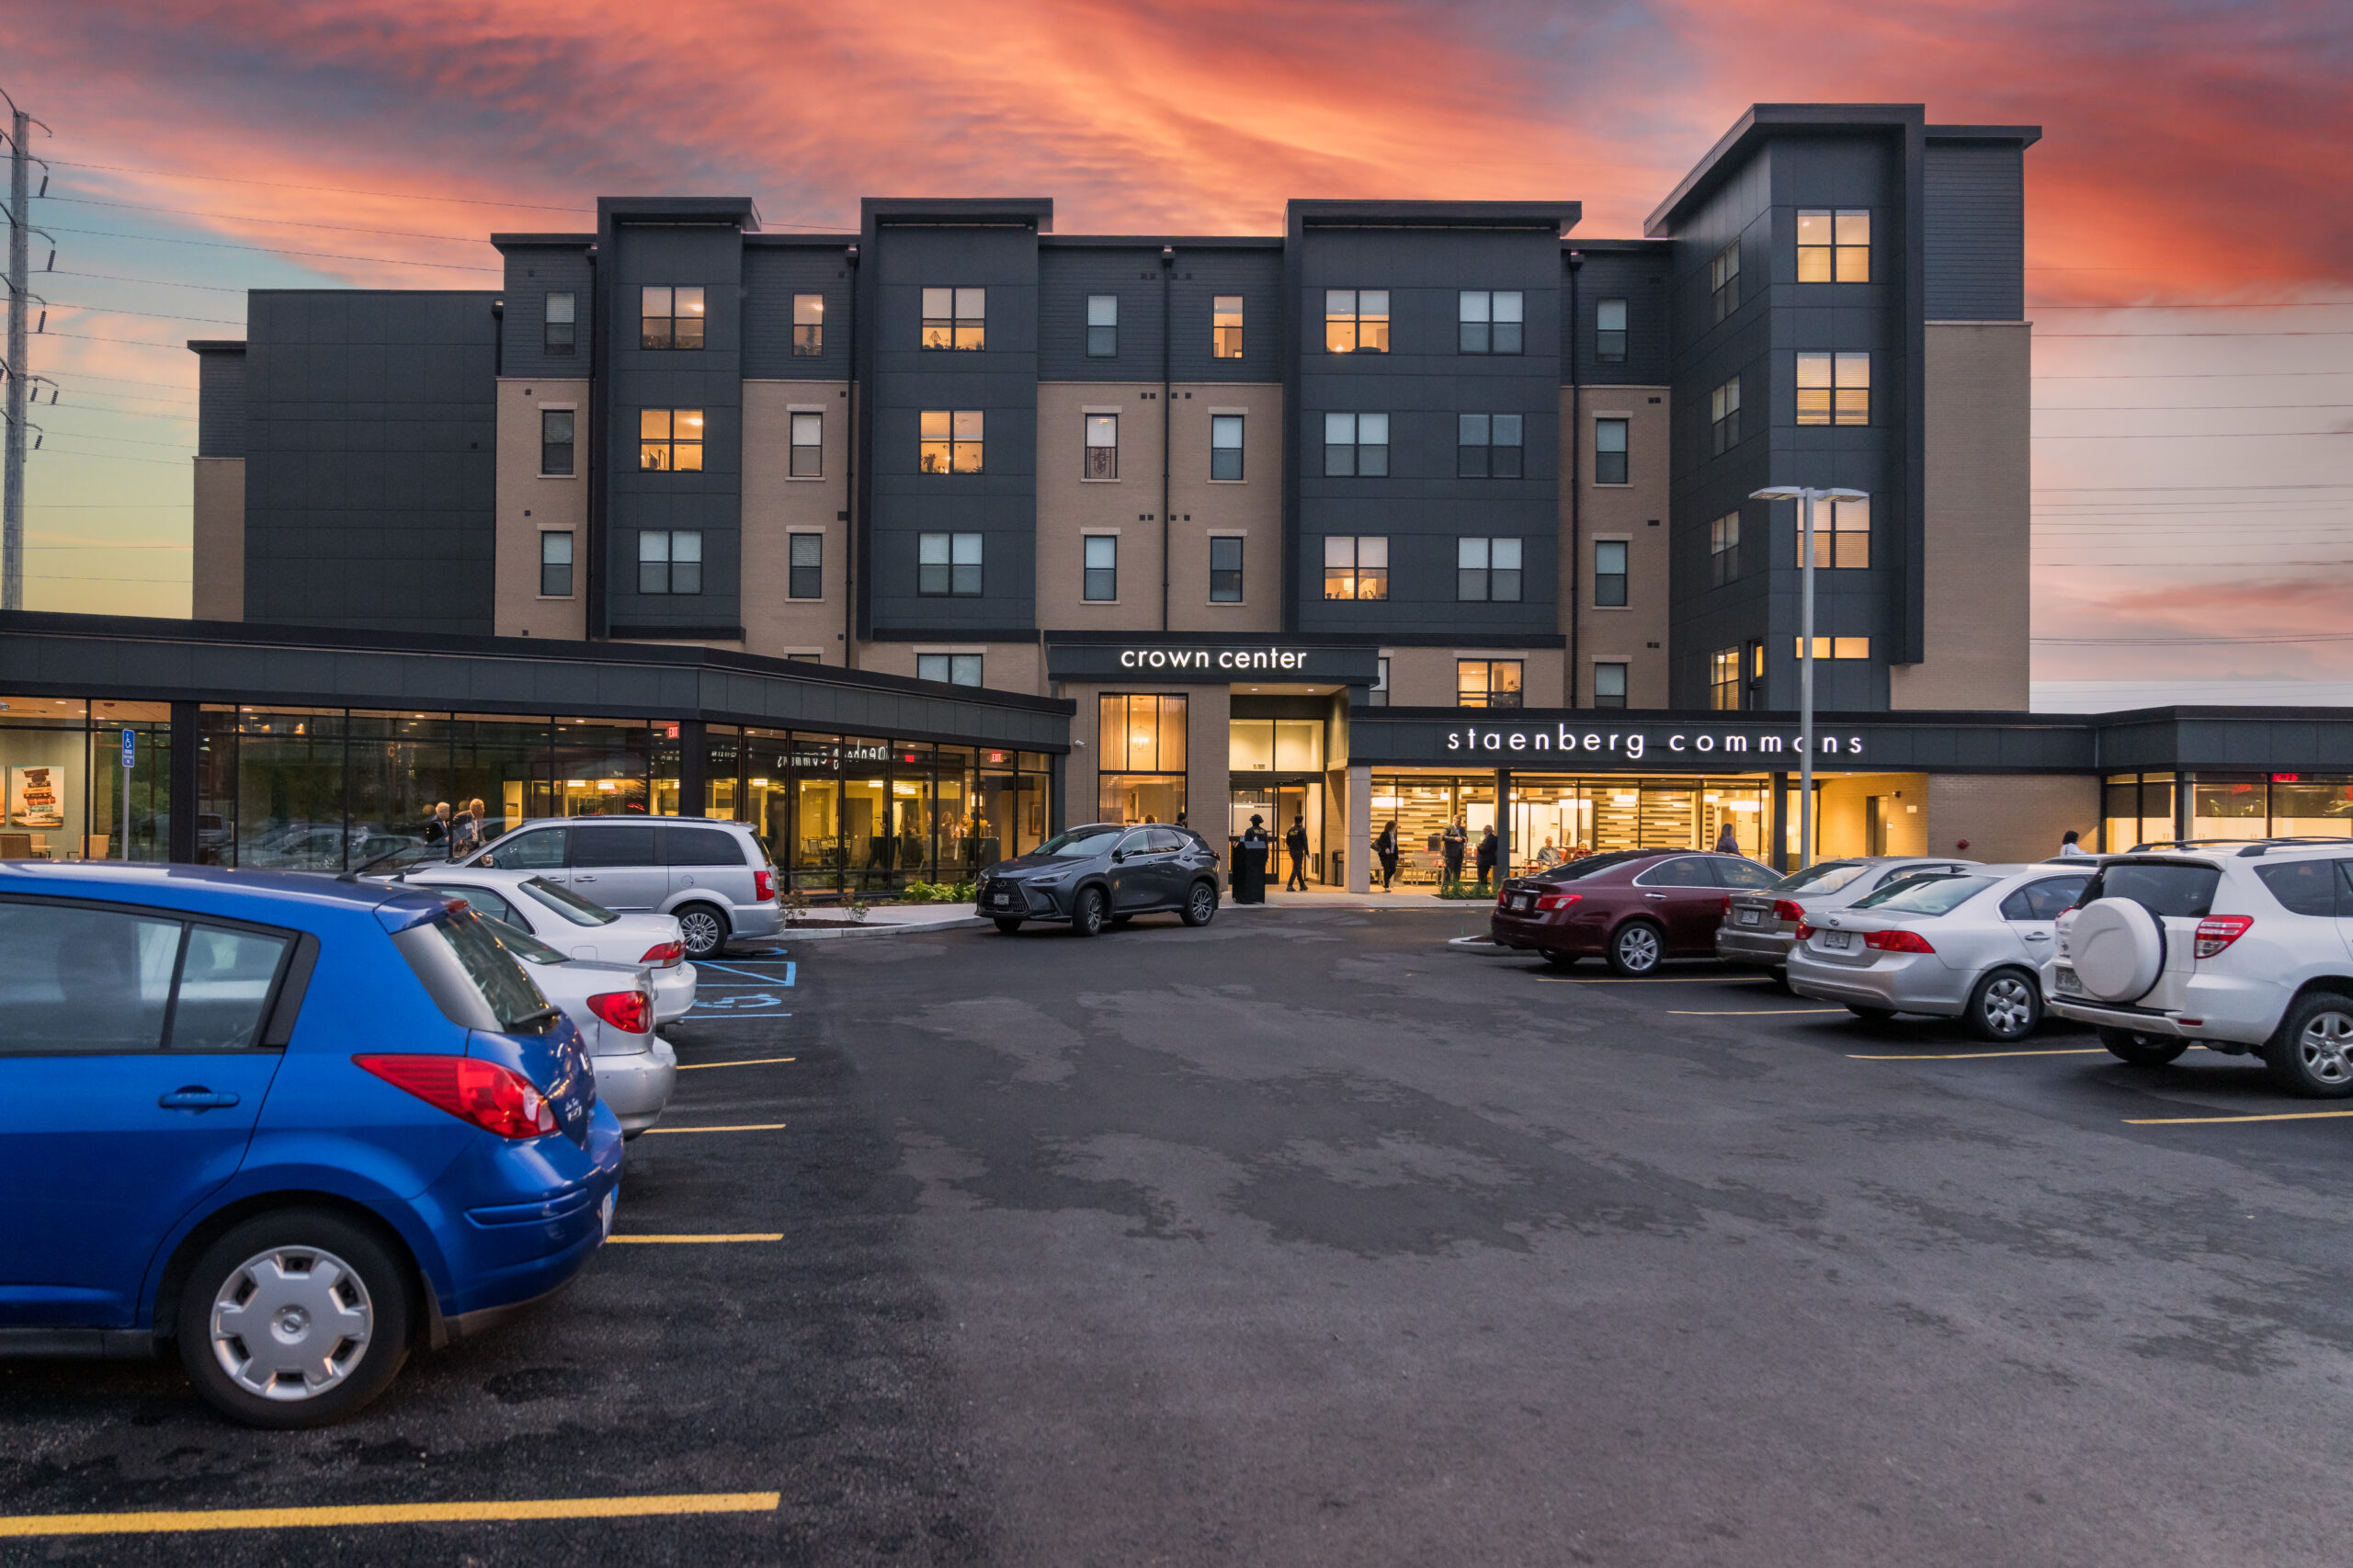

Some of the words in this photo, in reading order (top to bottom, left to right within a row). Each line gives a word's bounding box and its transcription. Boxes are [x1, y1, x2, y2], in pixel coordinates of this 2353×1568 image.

[1120, 650, 1210, 668] crown
[1218, 647, 1308, 669] center
[1447, 723, 1644, 759] staenberg
[1668, 734, 1862, 754] commons
